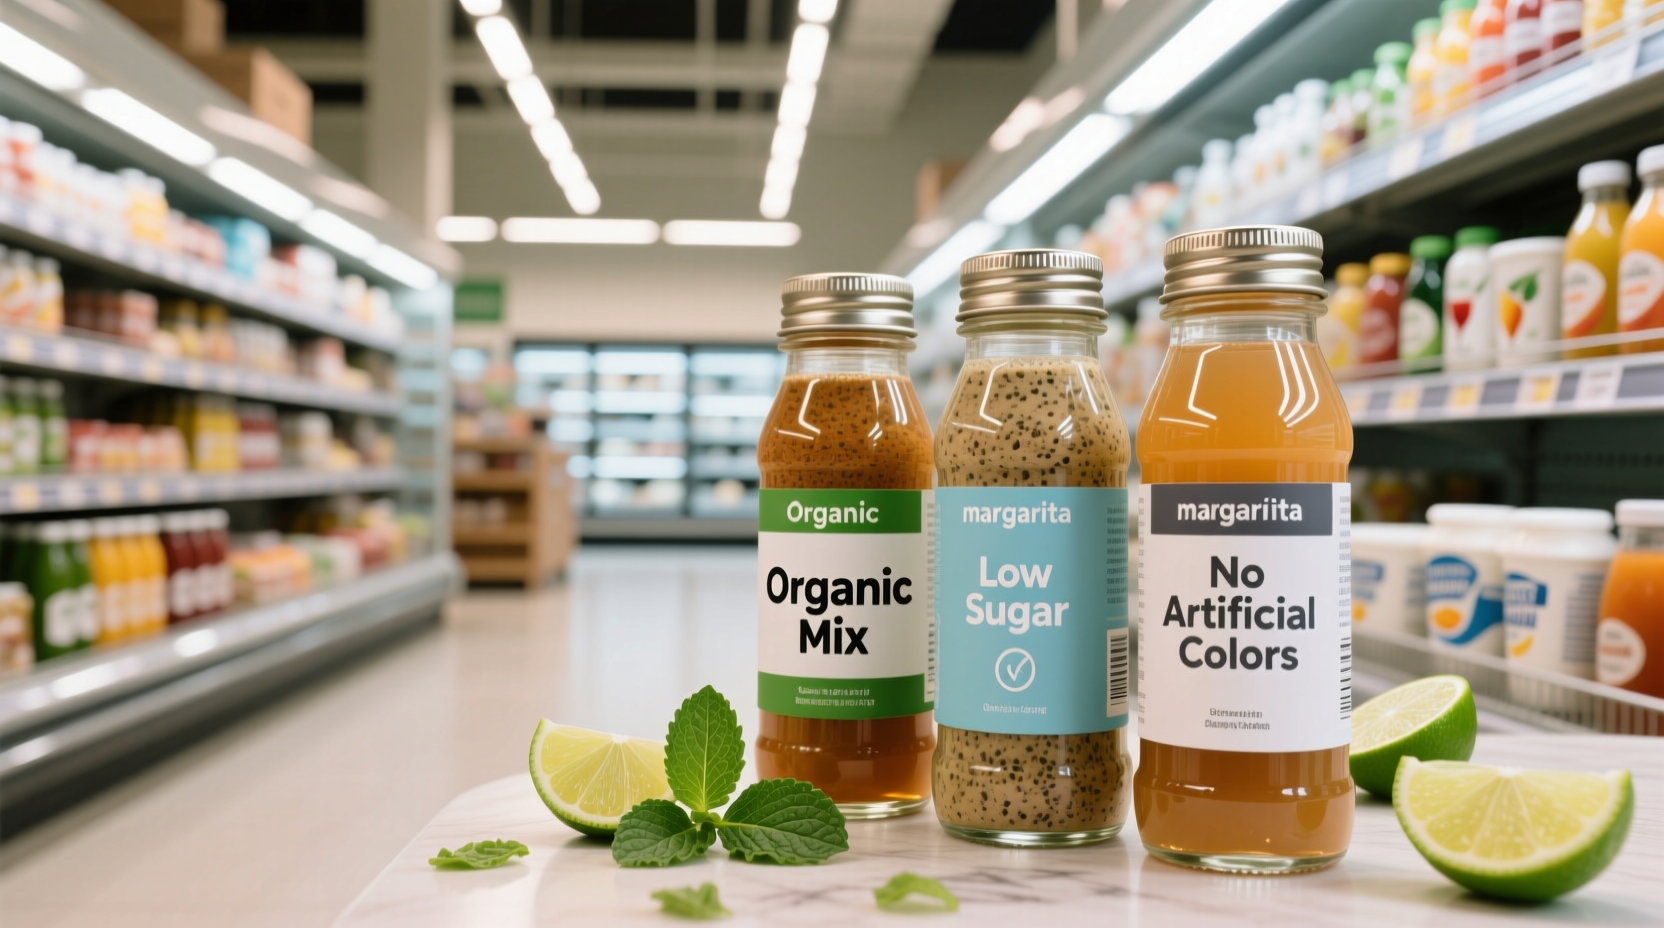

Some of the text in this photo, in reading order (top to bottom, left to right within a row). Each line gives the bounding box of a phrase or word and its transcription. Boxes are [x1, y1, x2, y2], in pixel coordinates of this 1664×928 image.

[786, 500, 879, 530] Organic
[962, 500, 1071, 530] margarita
[1177, 497, 1303, 527] margariita
[978, 555, 1053, 589] Low
[1210, 555, 1265, 589] No
[766, 566, 913, 616] Organic
[965, 593, 1070, 635] Sugar
[1162, 594, 1316, 631] Artificial
[799, 618, 869, 656] Mix
[1178, 635, 1299, 671] Colors
